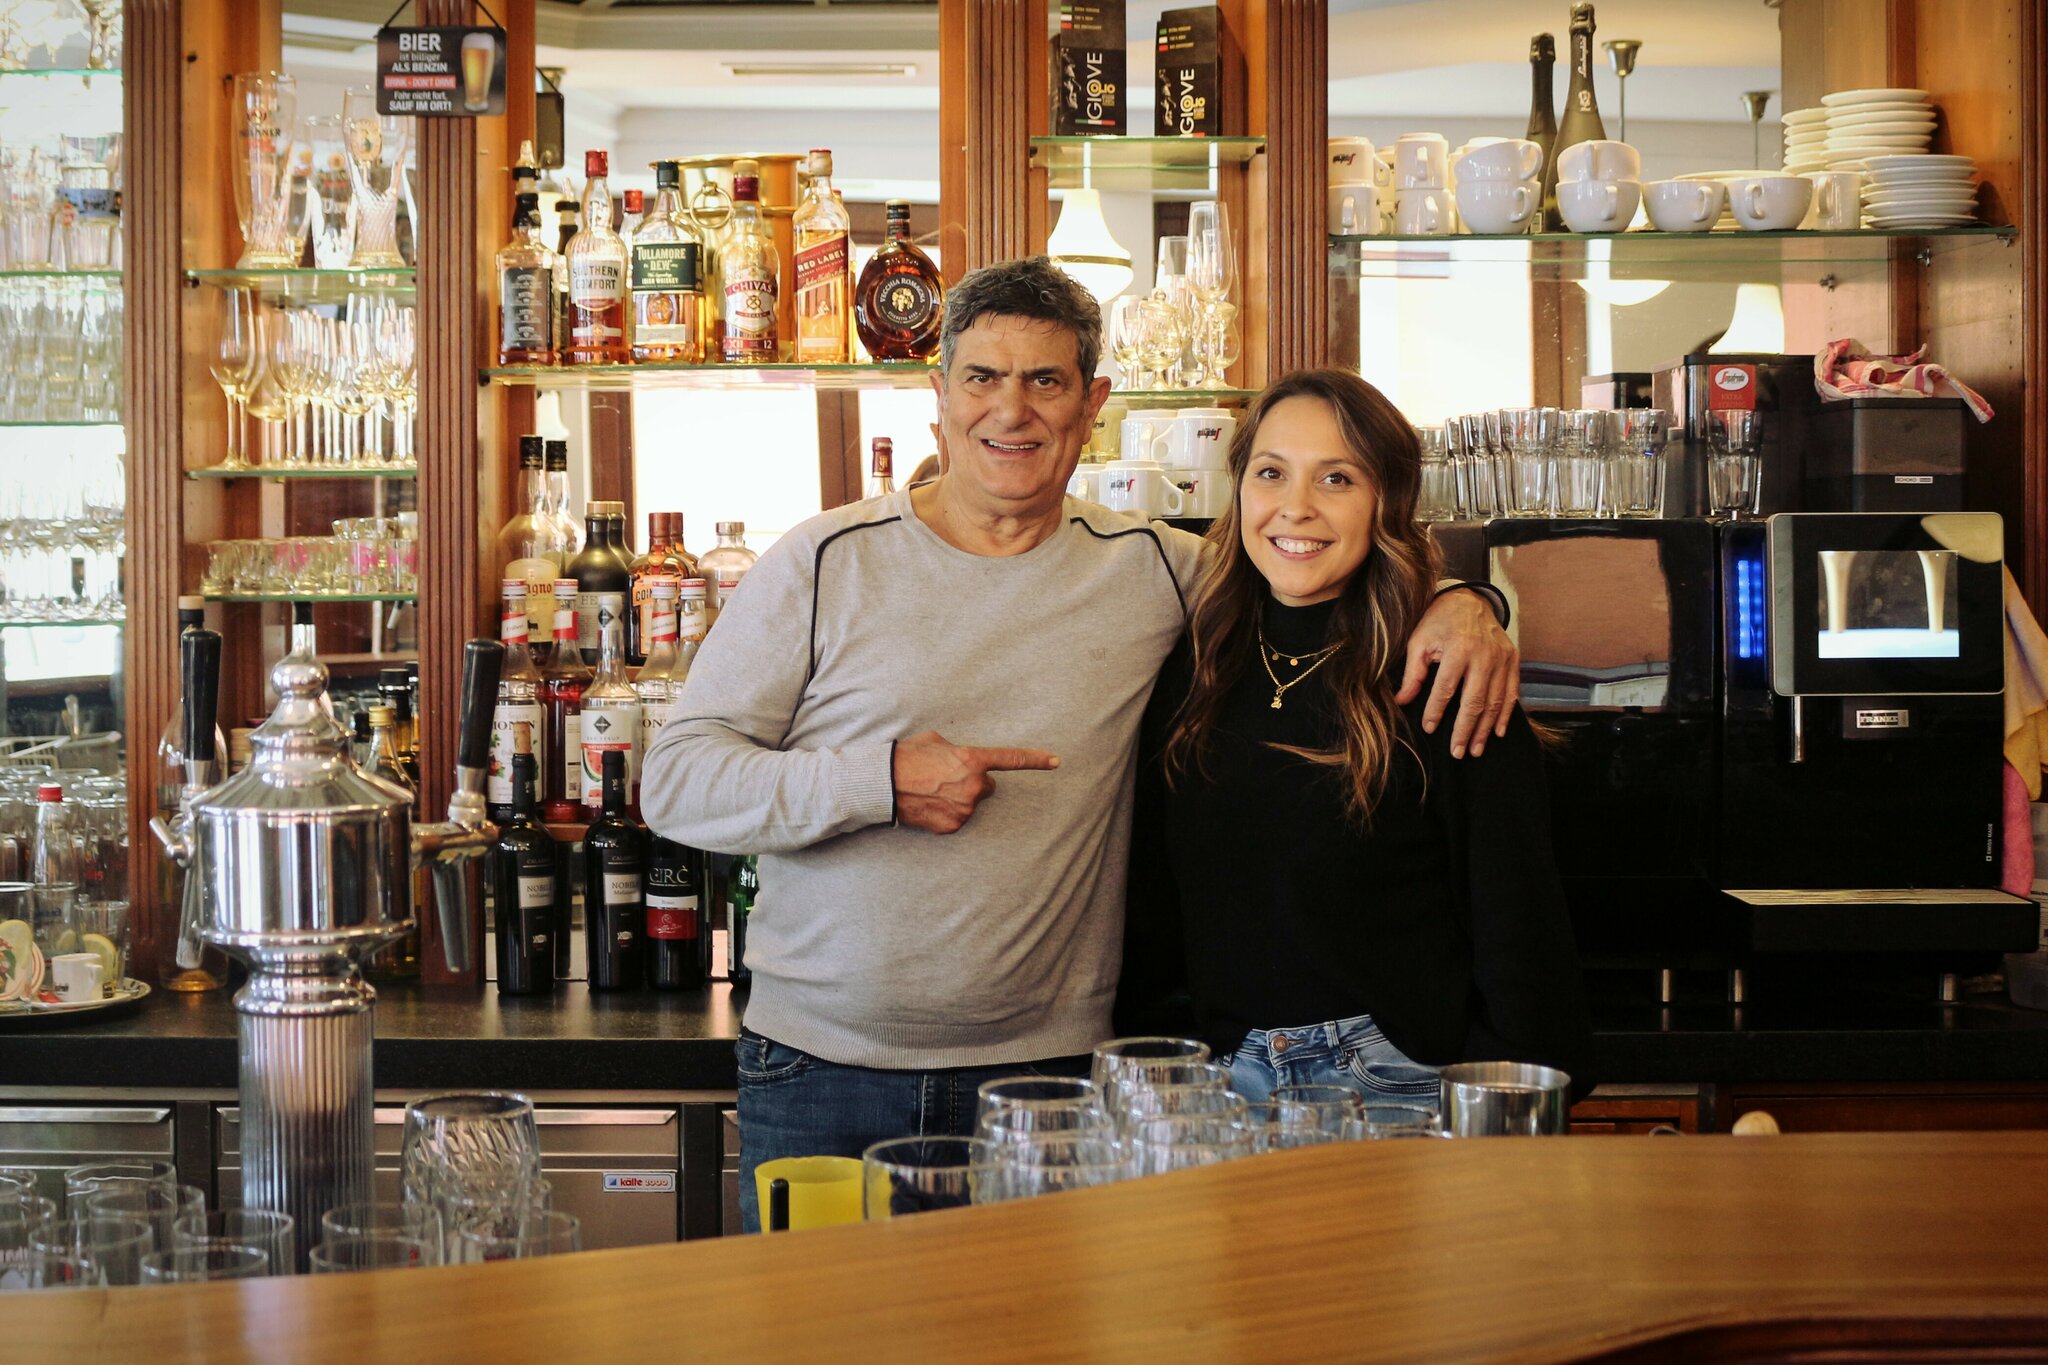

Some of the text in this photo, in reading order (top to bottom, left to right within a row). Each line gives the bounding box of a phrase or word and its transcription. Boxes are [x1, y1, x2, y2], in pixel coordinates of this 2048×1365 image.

[399, 33, 442, 52] BIER
[392, 62, 448, 72] ALS BENZIN
[394, 91, 411, 100] Fahr
[412, 91, 431, 100] nicht
[389, 101, 452, 111] SAUF IM ORT!
[636, 246, 687, 260] TULLAMORE
[650, 260, 671, 271] DEW
[797, 260, 816, 273] RED
[817, 249, 845, 265] LABEL
[573, 265, 619, 279] SOUTHERN
[576, 279, 616, 290] COMFORT
[732, 280, 772, 293] CHIVAS
[880, 277, 926, 303] VECCHIA ROMAGNA
[763, 339, 773, 349] 12
